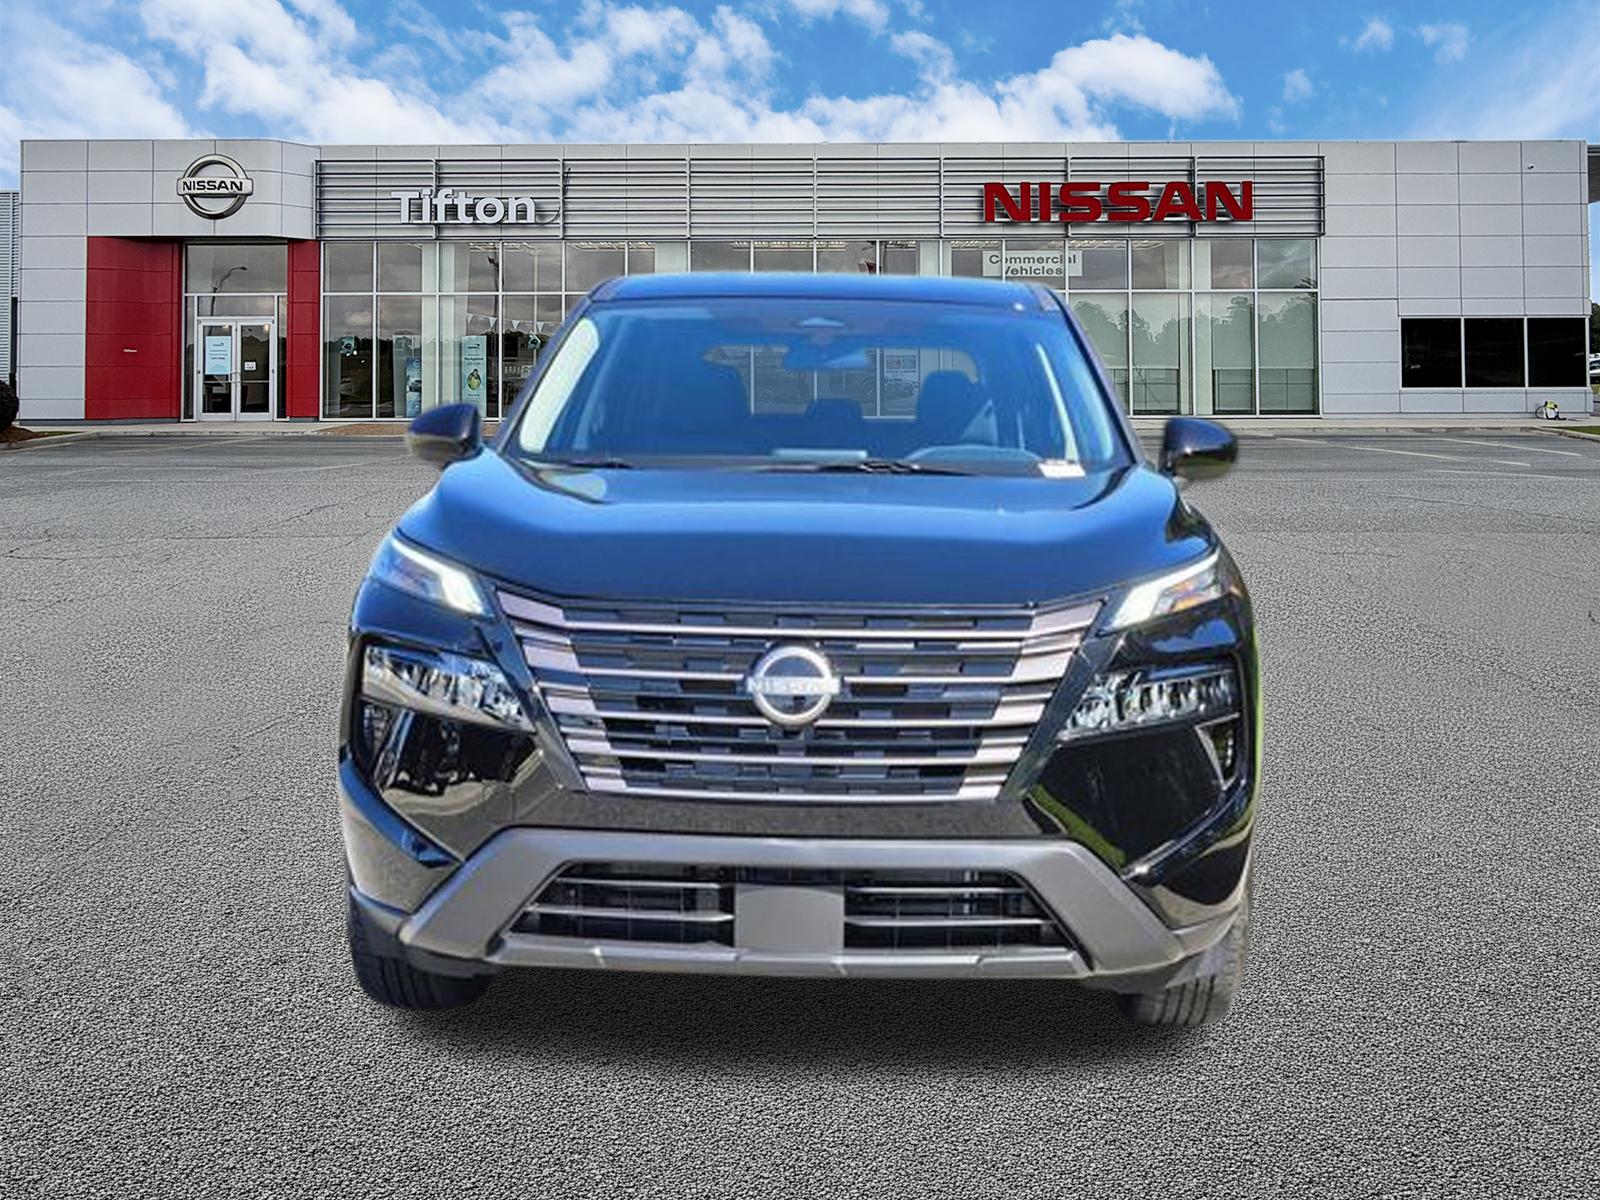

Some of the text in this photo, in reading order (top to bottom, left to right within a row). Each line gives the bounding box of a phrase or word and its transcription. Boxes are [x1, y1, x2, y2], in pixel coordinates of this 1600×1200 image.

[182, 180, 243, 192] NISSAN
[983, 180, 1254, 222] NISSAN
[390, 187, 536, 224] Tifton
